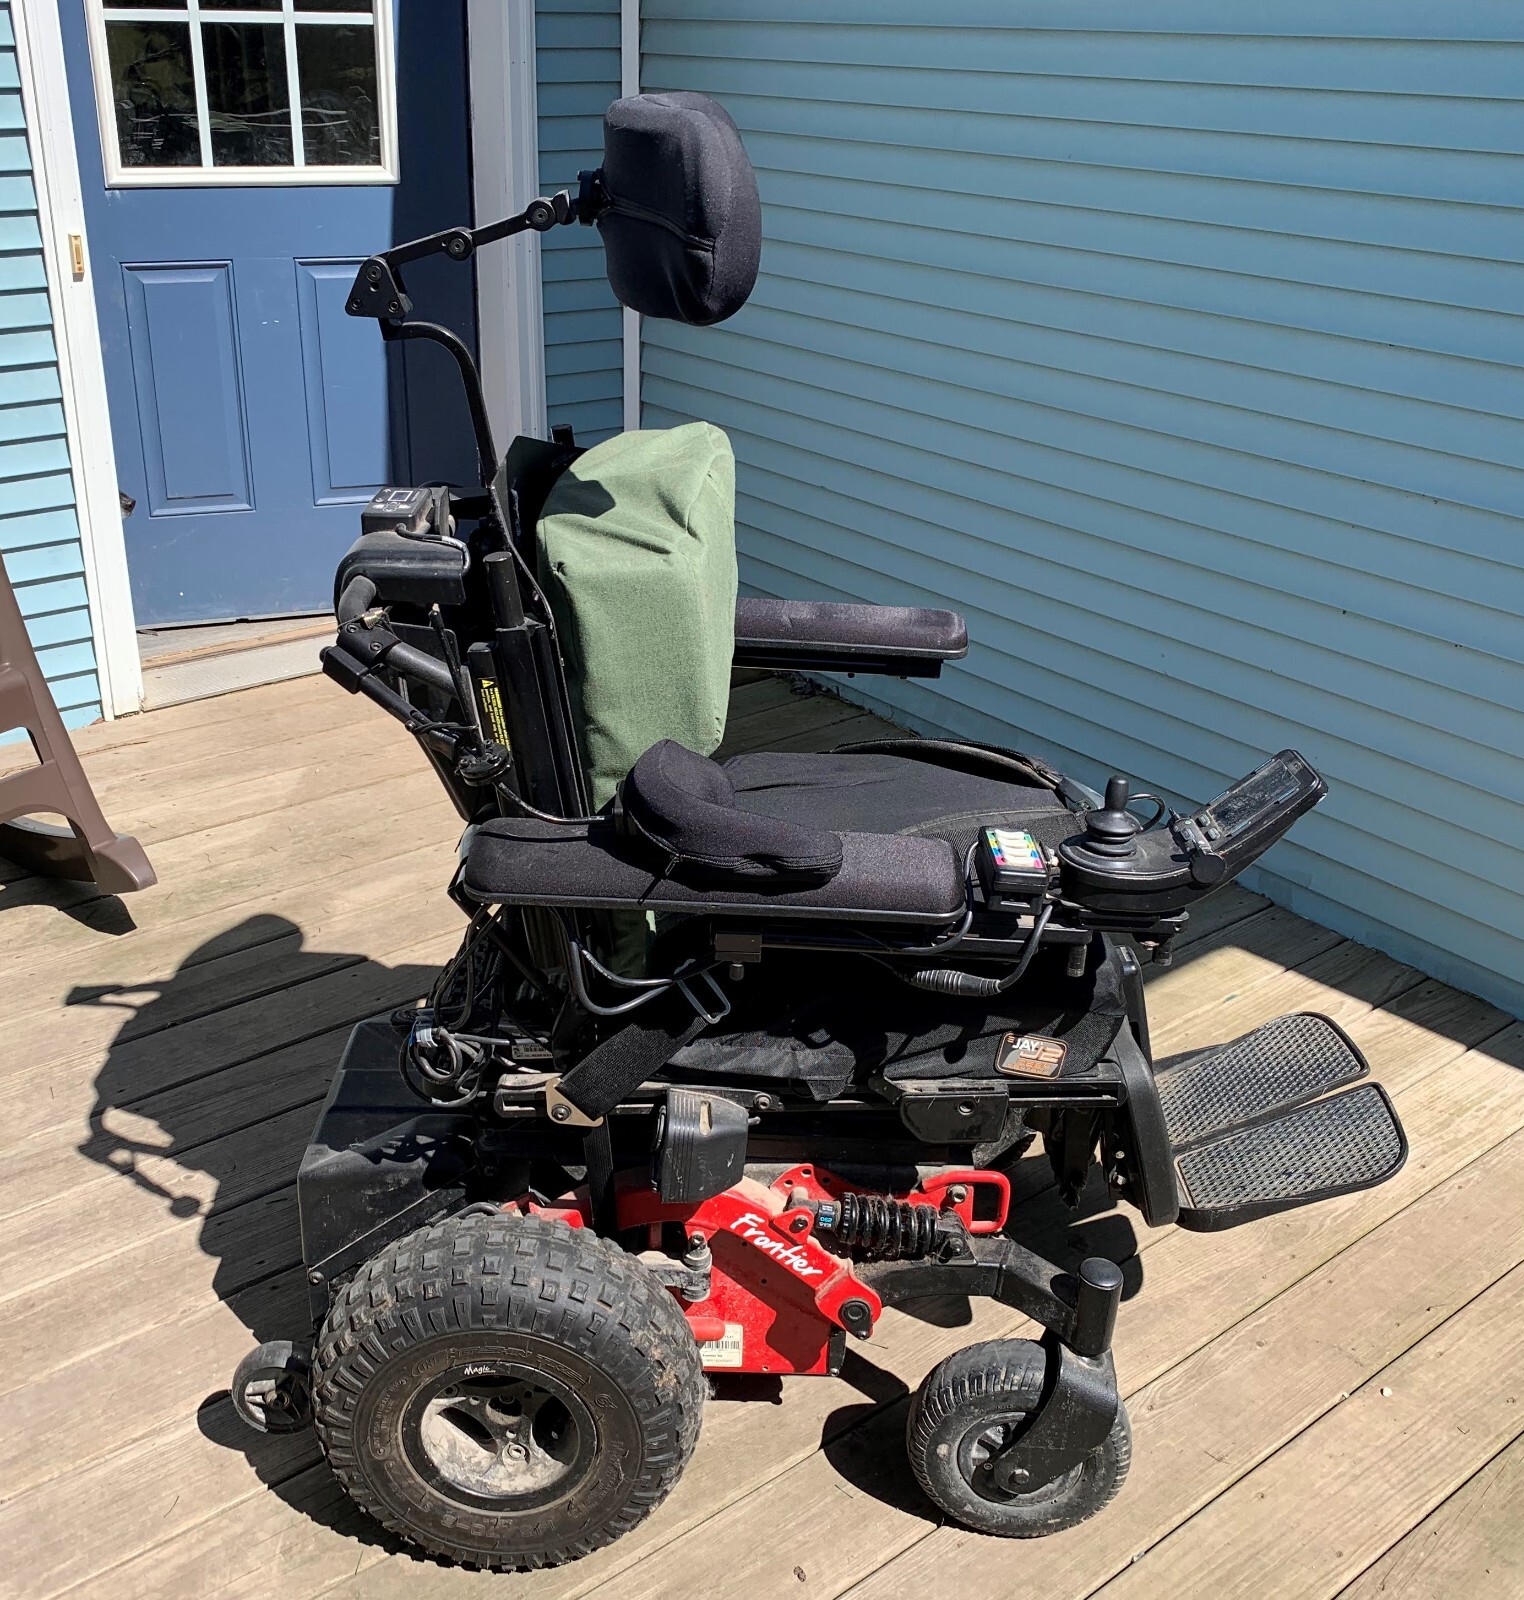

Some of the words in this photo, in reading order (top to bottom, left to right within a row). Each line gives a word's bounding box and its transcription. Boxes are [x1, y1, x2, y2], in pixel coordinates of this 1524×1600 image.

[1012, 1038, 1041, 1052] JAY
[1020, 1046, 1064, 1063] J2
[730, 1213, 823, 1276] Frontier
[464, 1364, 493, 1376] Magic
